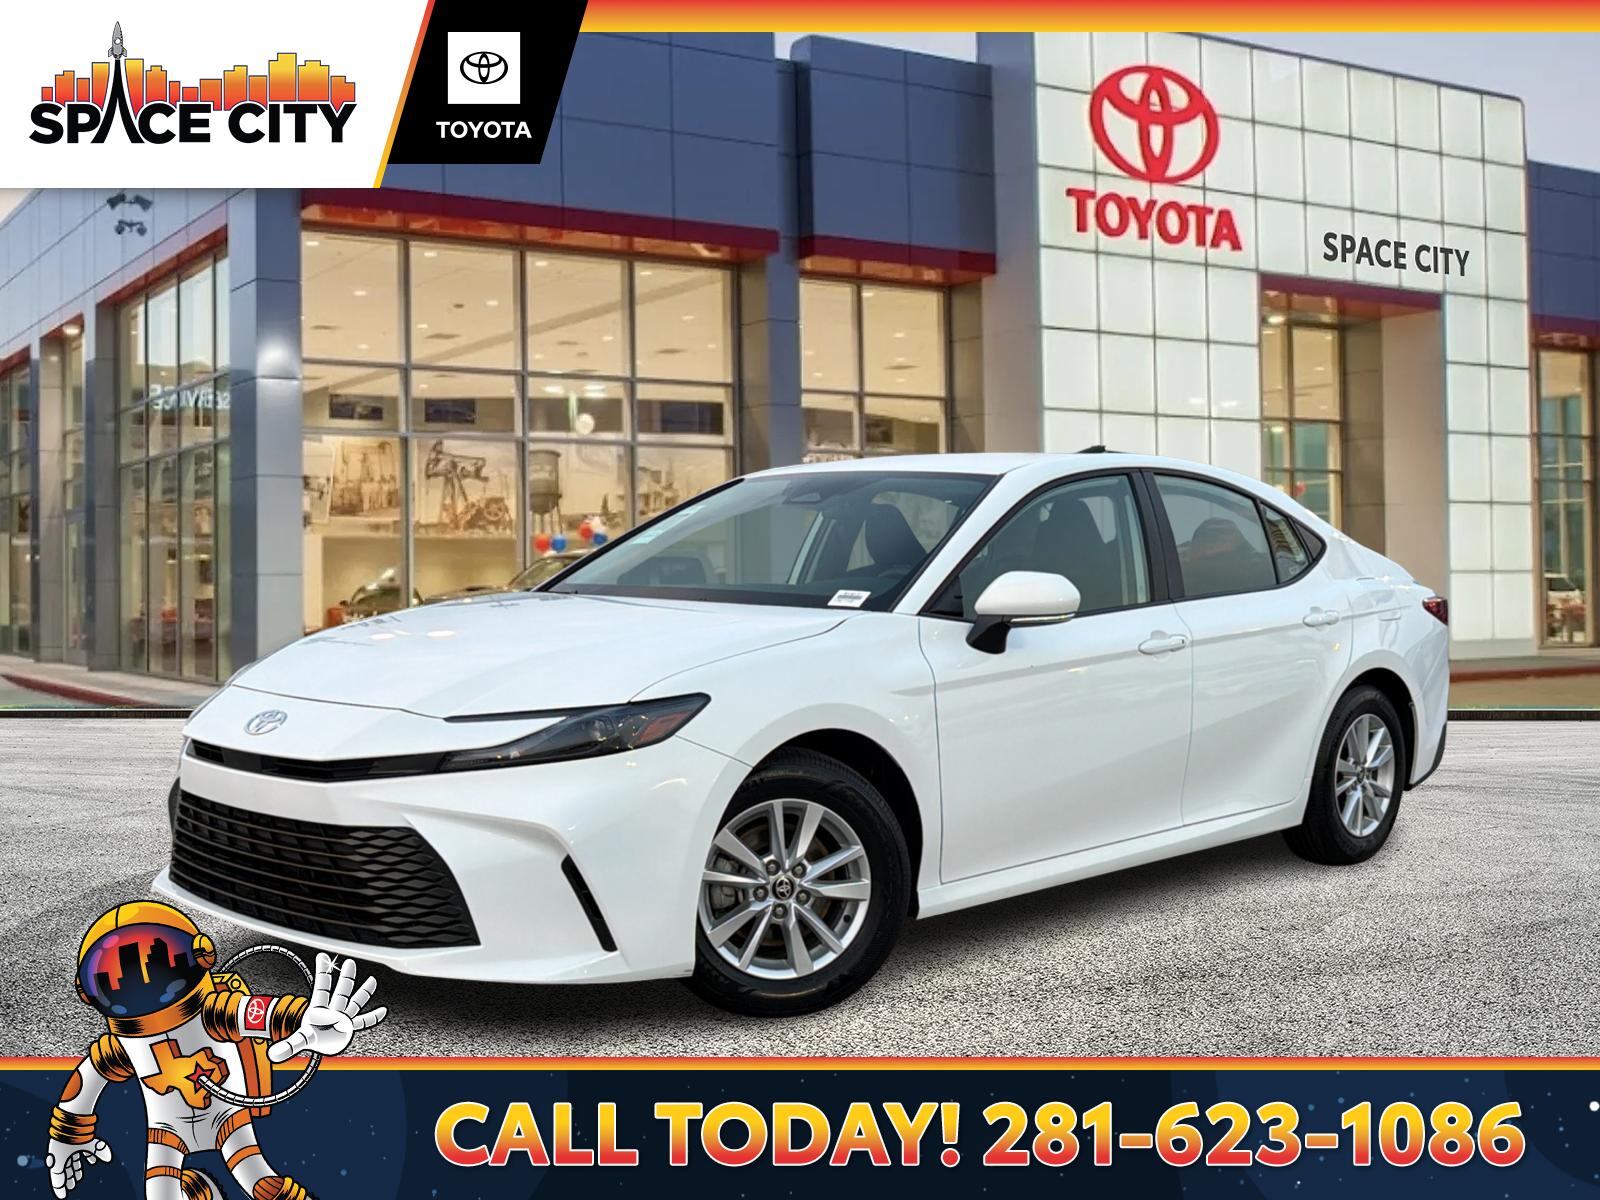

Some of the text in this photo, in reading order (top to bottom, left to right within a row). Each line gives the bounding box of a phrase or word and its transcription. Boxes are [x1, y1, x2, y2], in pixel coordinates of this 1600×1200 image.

[1066, 188, 1243, 251] TOYOTA
[1322, 231, 1470, 277] SPACE CITY
